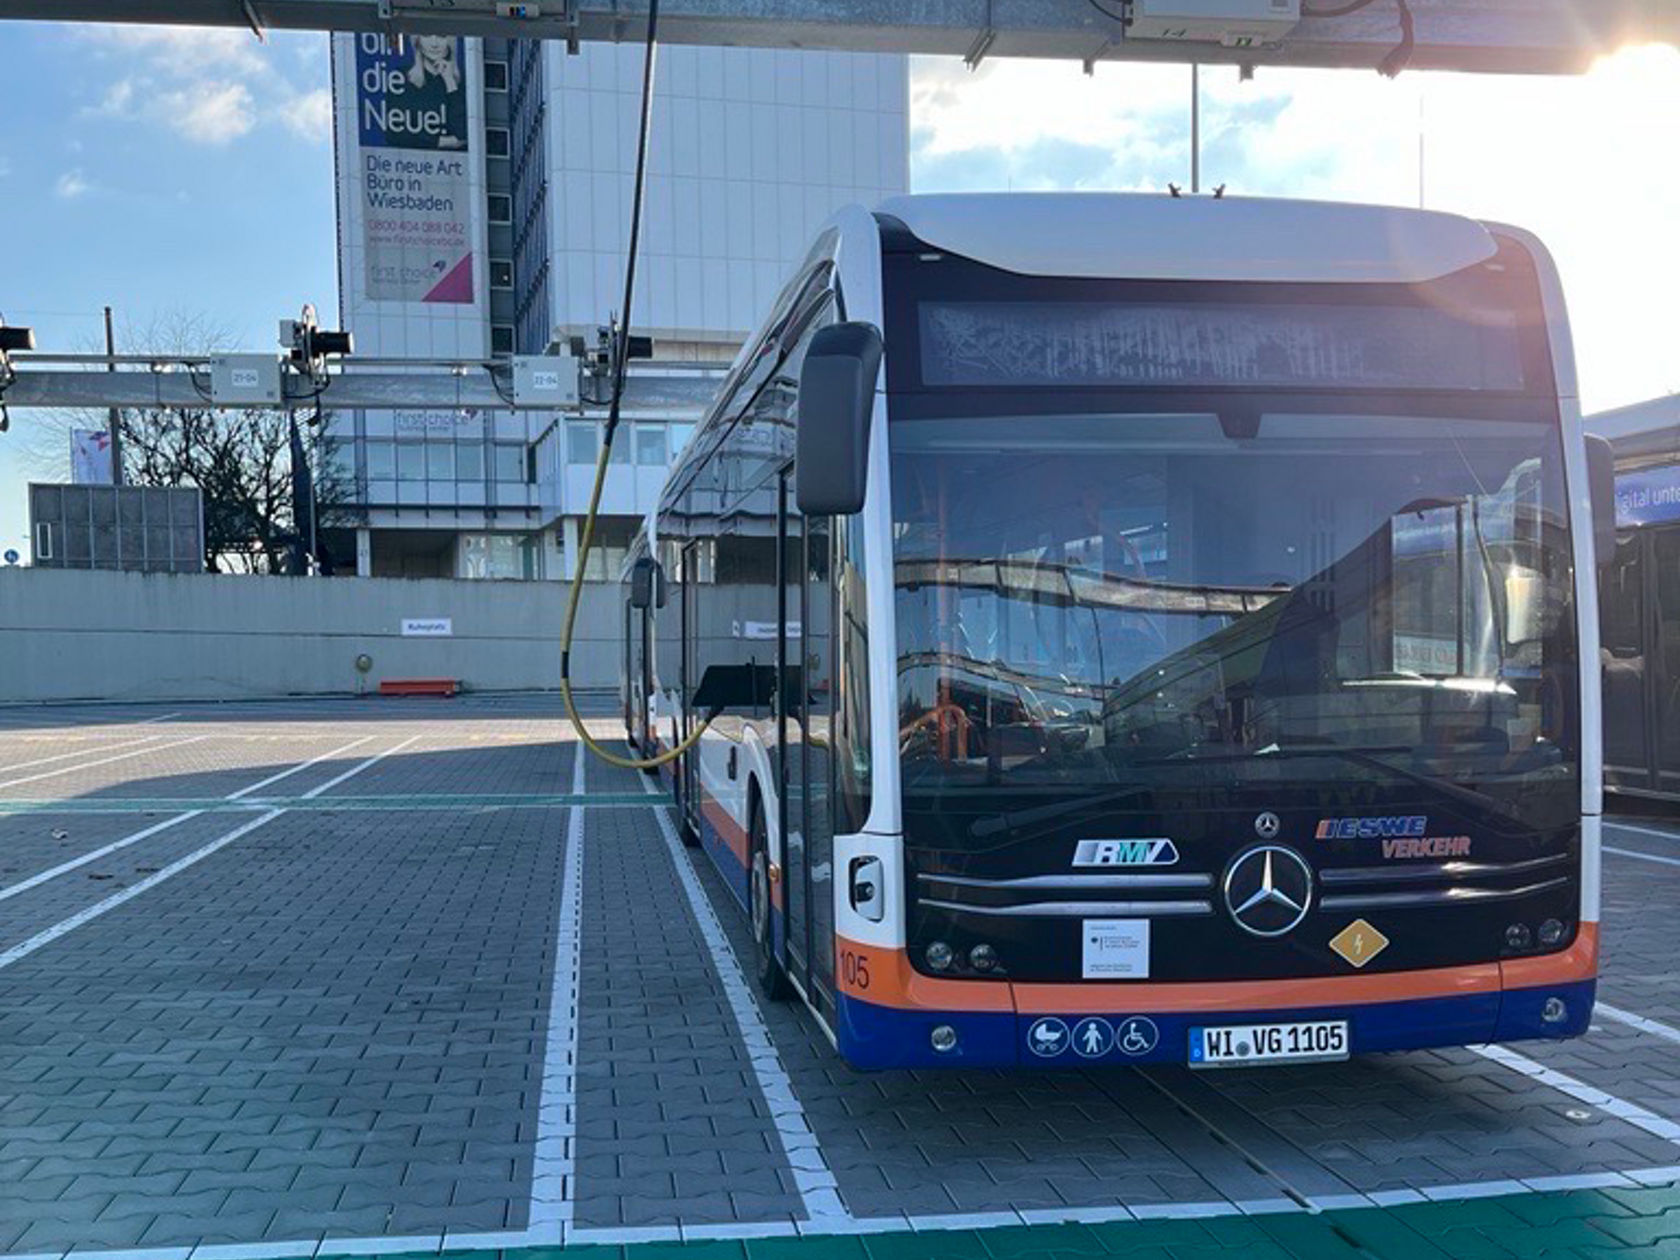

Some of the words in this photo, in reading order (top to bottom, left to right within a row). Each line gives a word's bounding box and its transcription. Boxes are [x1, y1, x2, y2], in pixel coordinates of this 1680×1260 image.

[363, 61, 406, 95] die
[364, 98, 447, 135] Neue!
[367, 155, 391, 172] Die
[395, 159, 433, 175] neue
[437, 160, 462, 176] Art
[367, 173, 404, 191] Büro
[408, 176, 421, 191] in
[367, 192, 454, 211] Wiesbaden
[368, 219, 396, 232] 0800
[400, 220, 420, 233] 404
[444, 221, 464, 235] 042
[1093, 839, 1167, 864] RMV
[1381, 835, 1472, 859] VERKEHR
[840, 950, 869, 989] 105
[1206, 1030, 1235, 1058] WI
[1252, 1027, 1283, 1055] VG
[1287, 1025, 1344, 1053] 1105
